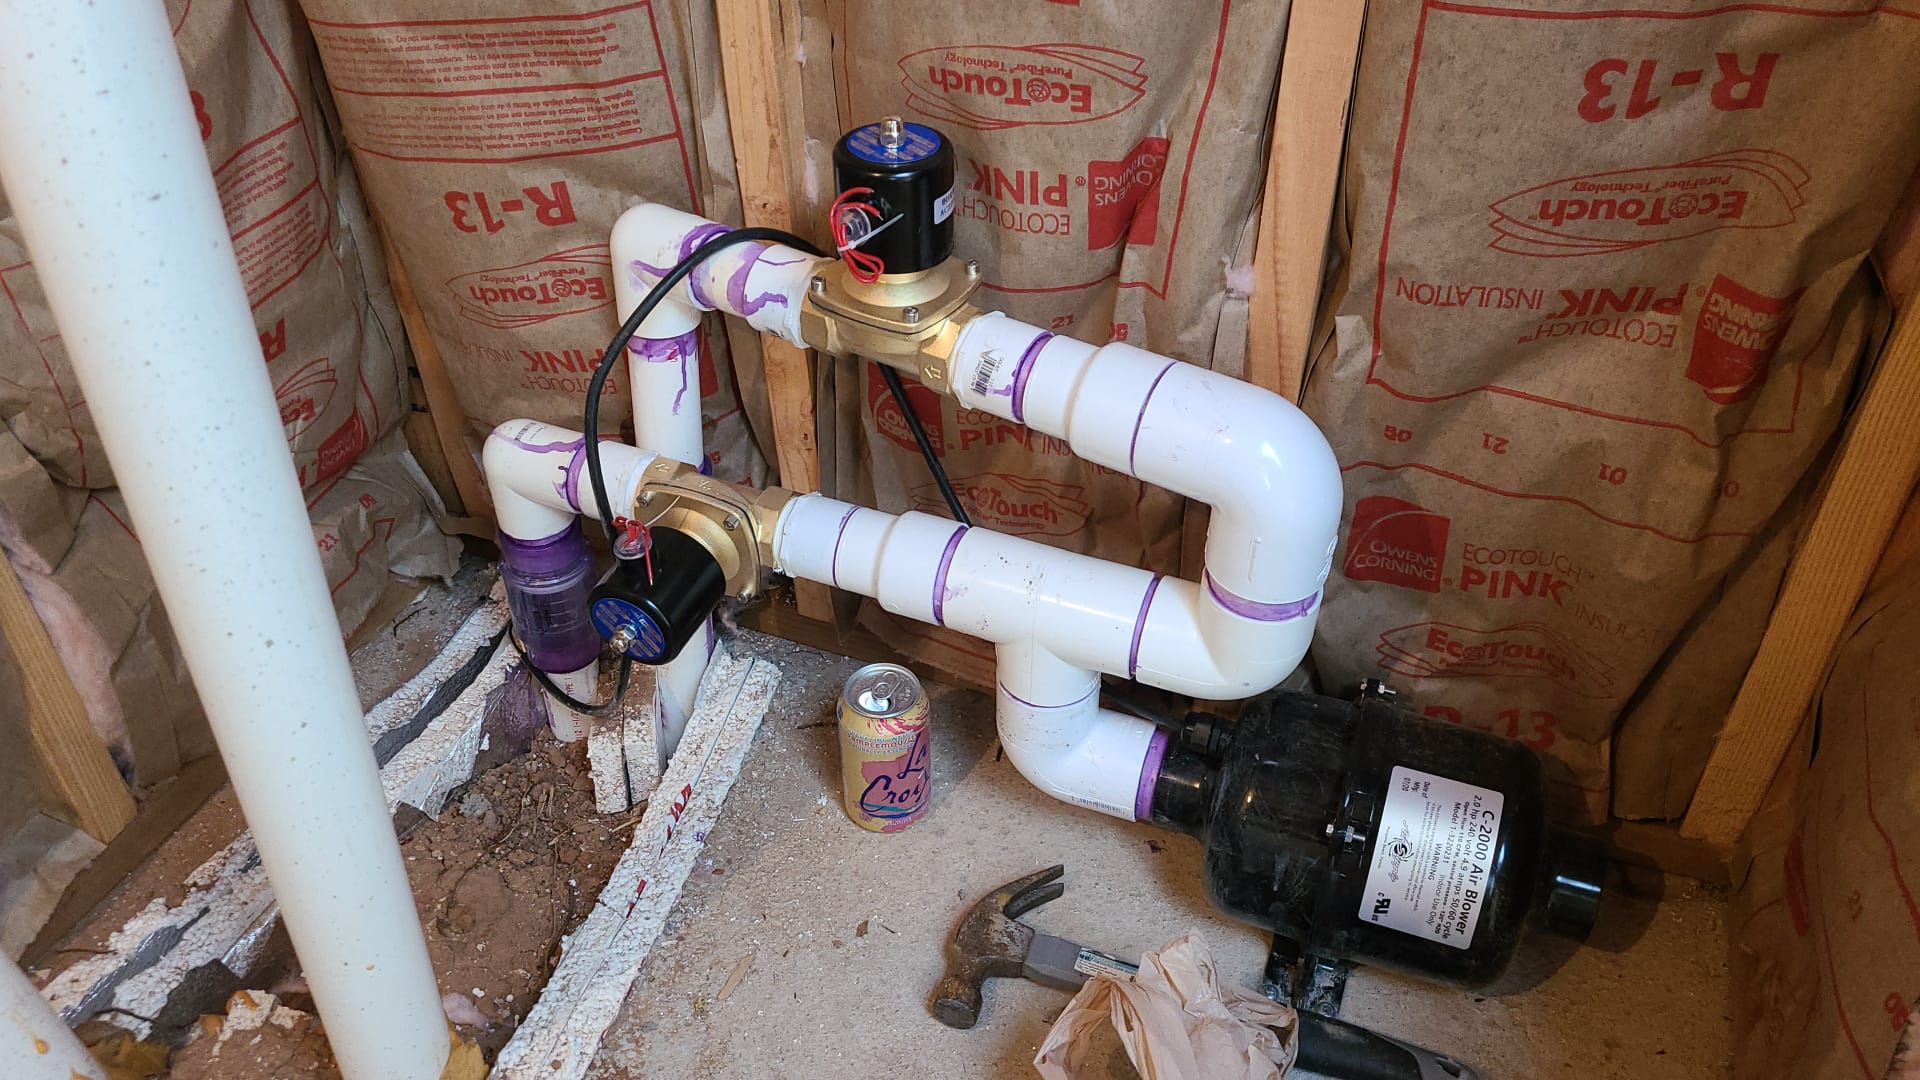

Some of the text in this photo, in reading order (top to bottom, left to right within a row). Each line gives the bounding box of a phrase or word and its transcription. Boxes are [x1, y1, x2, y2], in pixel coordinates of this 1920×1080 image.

[943, 51, 1006, 72] Technology
[1577, 51, 1781, 124] R-13
[969, 157, 1068, 207] PINK
[444, 180, 578, 235] R-13
[1395, 275, 1689, 319] PINK INSULATION
[520, 348, 604, 374] PINK
[1353, 553, 1437, 582] CORNING
[1369, 540, 1438, 569] OWENS
[1460, 565, 1569, 607] PINK
[1422, 781, 1430, 792] Date
[1450, 801, 1461, 824] Model
[1427, 842, 1442, 881] WARNING
[1441, 795, 1482, 939] 2.0 hp 240 volt 4.9 amps 50/60 cycle
[1455, 809, 1496, 936] C-2000 Air Blower
[1434, 873, 1445, 896] Indoor
[1425, 910, 1436, 926] Only
[1431, 897, 1439, 910] Use
